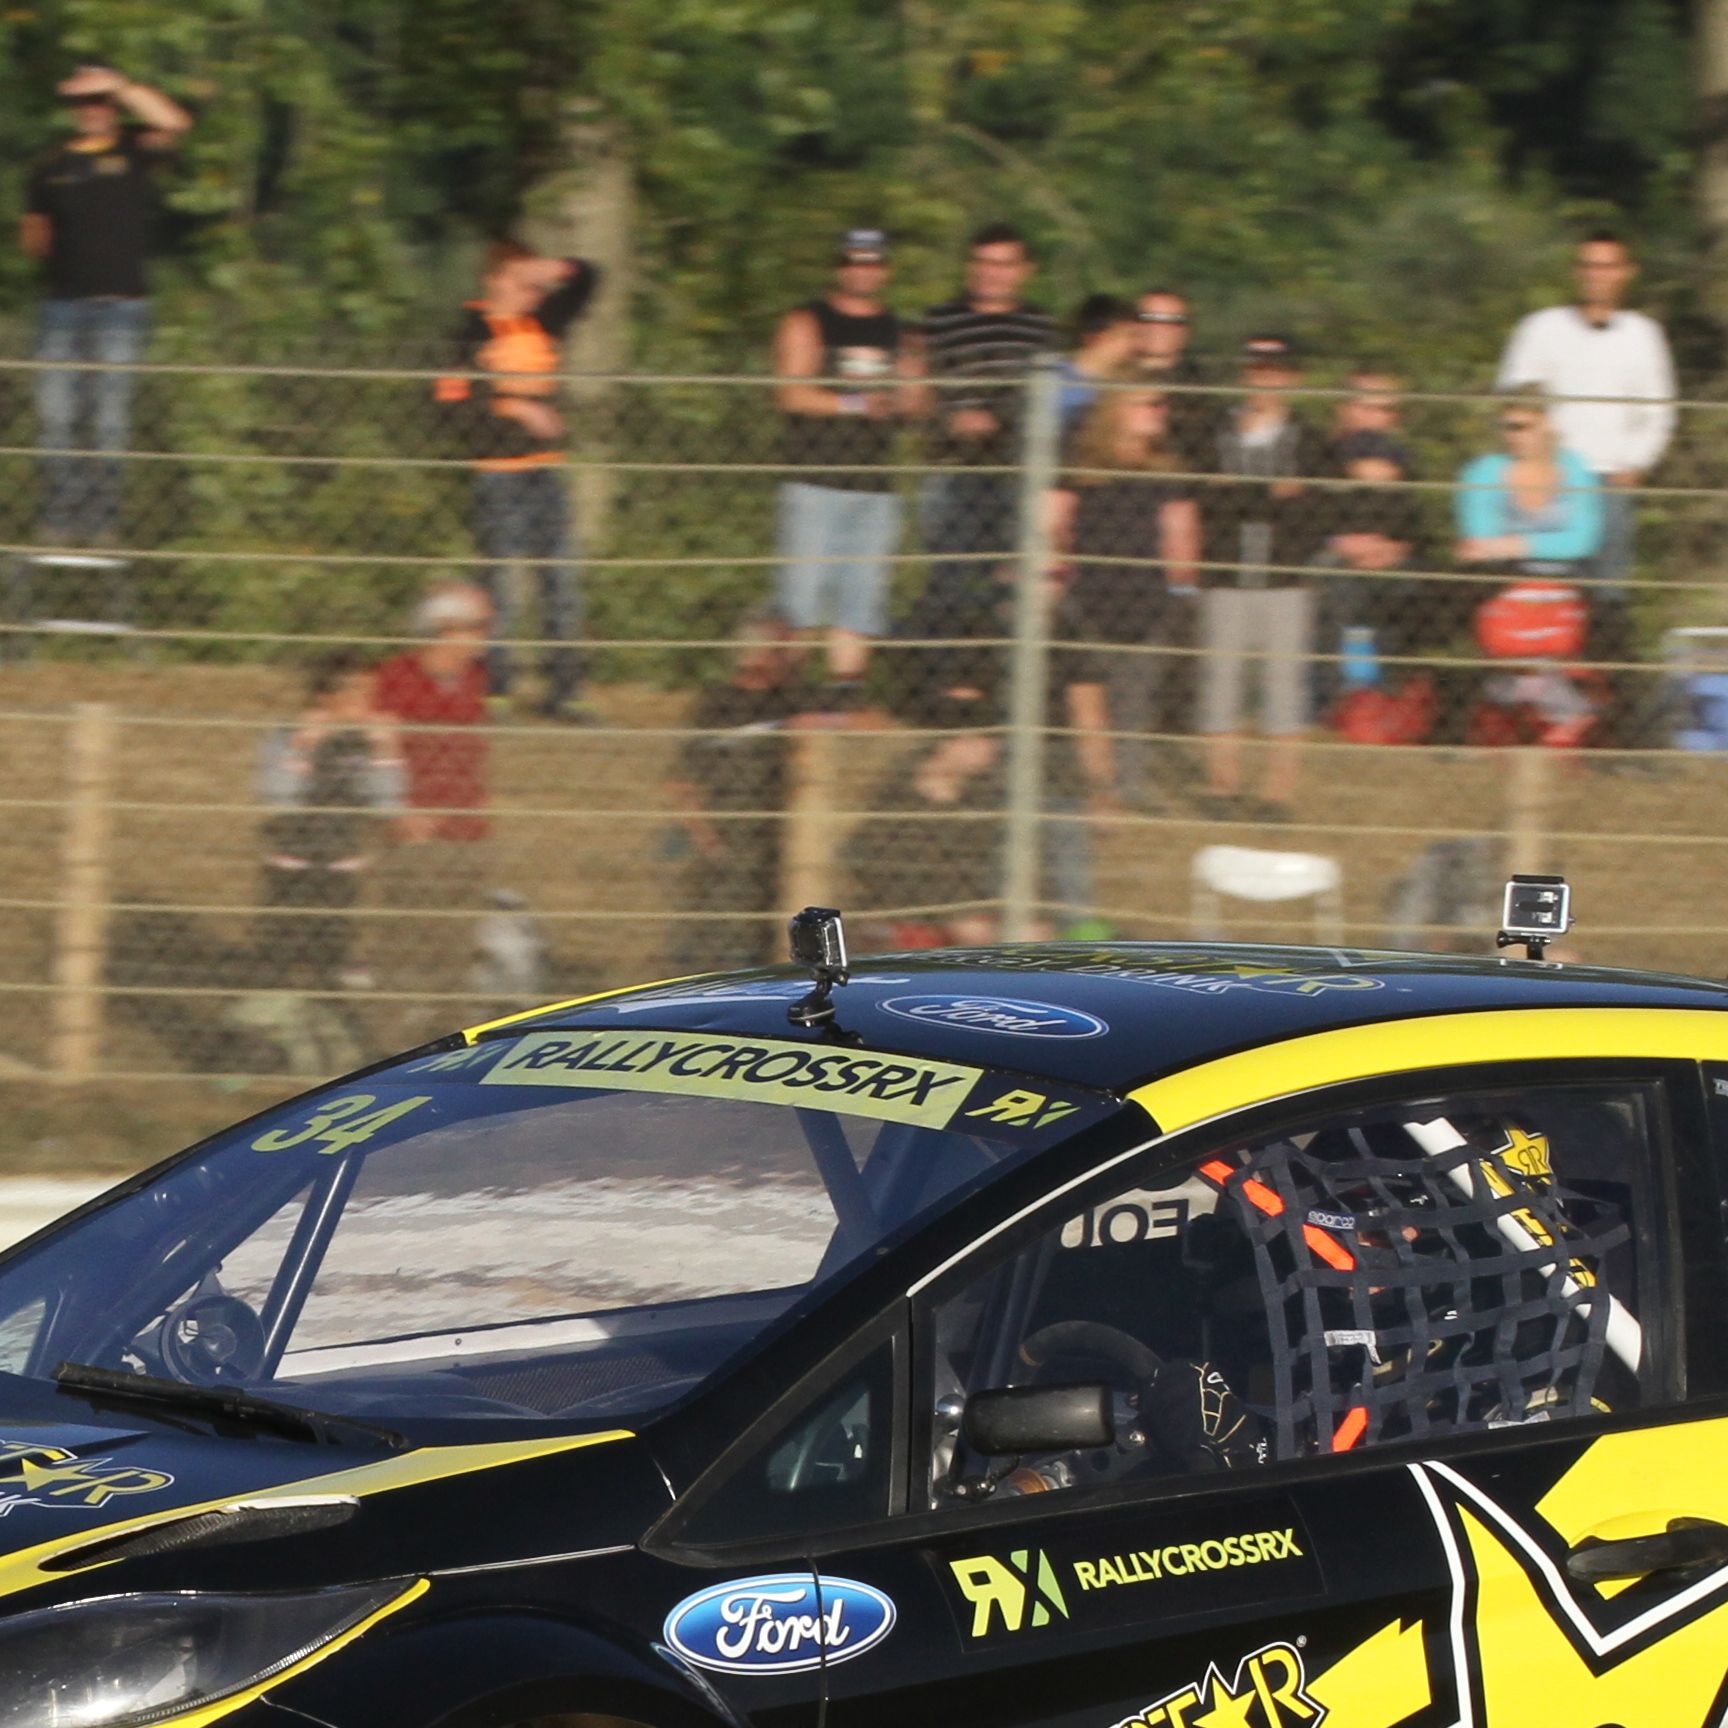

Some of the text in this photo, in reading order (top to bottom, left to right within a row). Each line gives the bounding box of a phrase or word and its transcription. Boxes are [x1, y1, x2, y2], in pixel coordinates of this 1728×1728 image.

[910, 1000, 1066, 1032] Ford
[502, 1038, 964, 1107] RALLYCROSSRX
[252, 1094, 432, 1155] 34
[1073, 1528, 1303, 1592] RALLYCROSSRX
[715, 1590, 850, 1656] Ford
